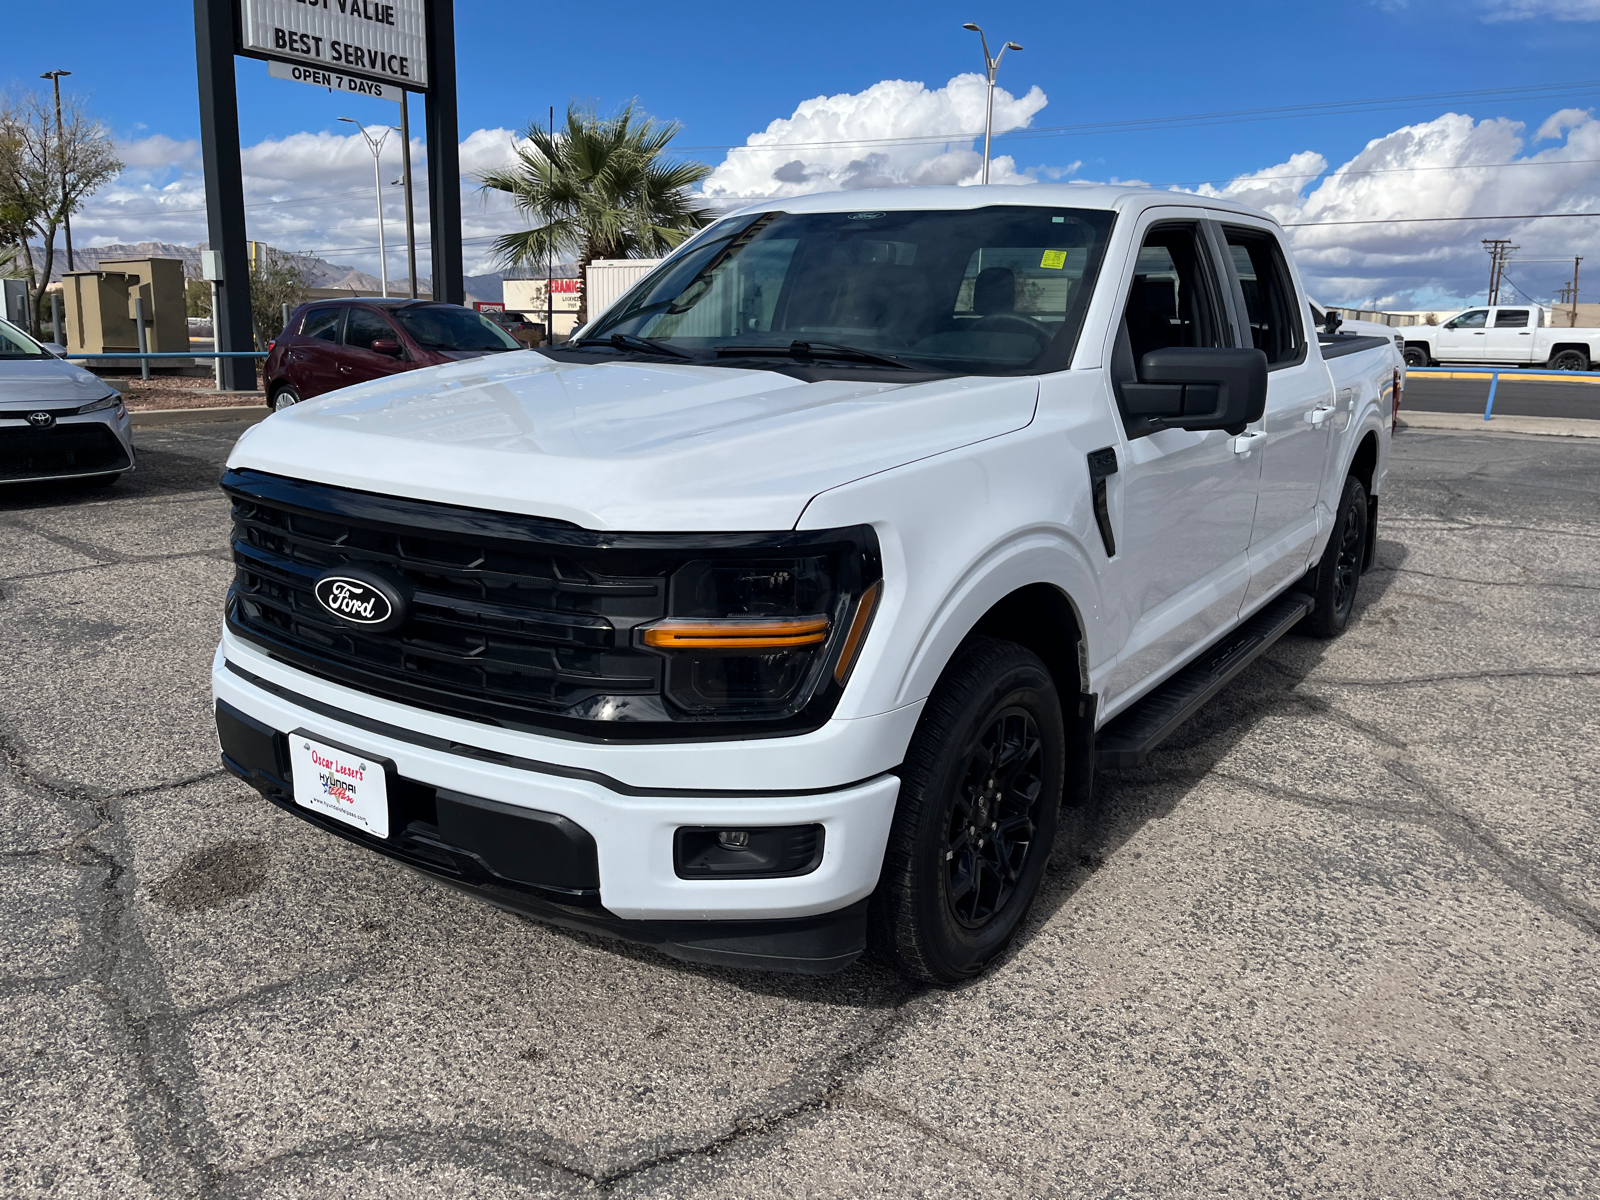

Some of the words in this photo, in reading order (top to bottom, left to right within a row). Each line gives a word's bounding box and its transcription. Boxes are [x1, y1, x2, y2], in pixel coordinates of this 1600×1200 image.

[337, 0, 395, 26] VALUE
[274, 27, 322, 57] BEST
[331, 40, 409, 77] SERVICE
[291, 66, 331, 86] OPEN
[335, 75, 344, 88] 7
[348, 78, 383, 97] DAYS
[328, 581, 376, 618] Ford
[311, 749, 334, 774] Oscar
[334, 759, 364, 782] Leeser's
[319, 772, 357, 795] HYUNDAI
